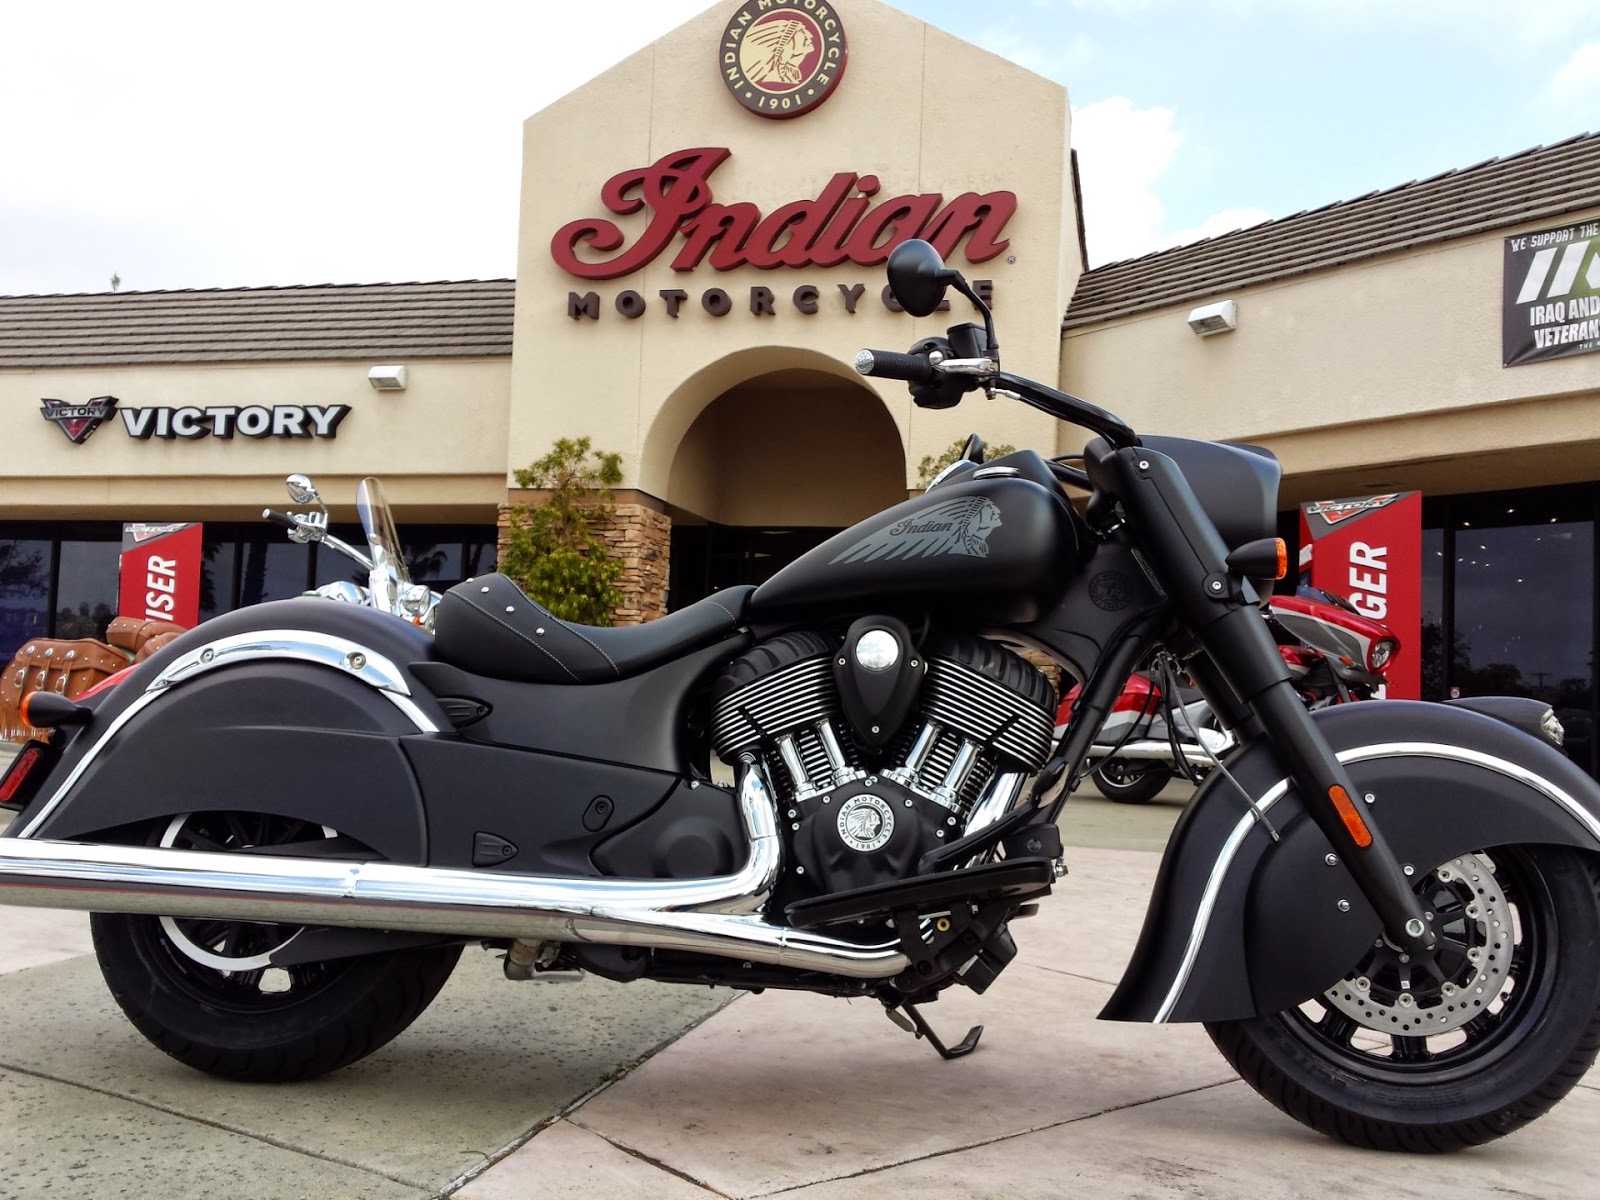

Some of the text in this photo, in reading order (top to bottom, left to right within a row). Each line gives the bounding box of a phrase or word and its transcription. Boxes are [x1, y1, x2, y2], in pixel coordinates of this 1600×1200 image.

[724, 11, 752, 90] INDIAN
[758, 94, 802, 109] 1901
[550, 146, 1018, 280] Indian
[1511, 222, 1599, 252] WE SUPPORT THE
[1530, 295, 1600, 327] IRAQ AND
[1534, 319, 1600, 349] VETERAN
[45, 407, 107, 417] VICTORY
[120, 404, 351, 439] VICTORY
[1310, 500, 1387, 512] VICTORY
[889, 518, 953, 537] Indian
[839, 796, 892, 840] INDIAN MOTORCYCLE
